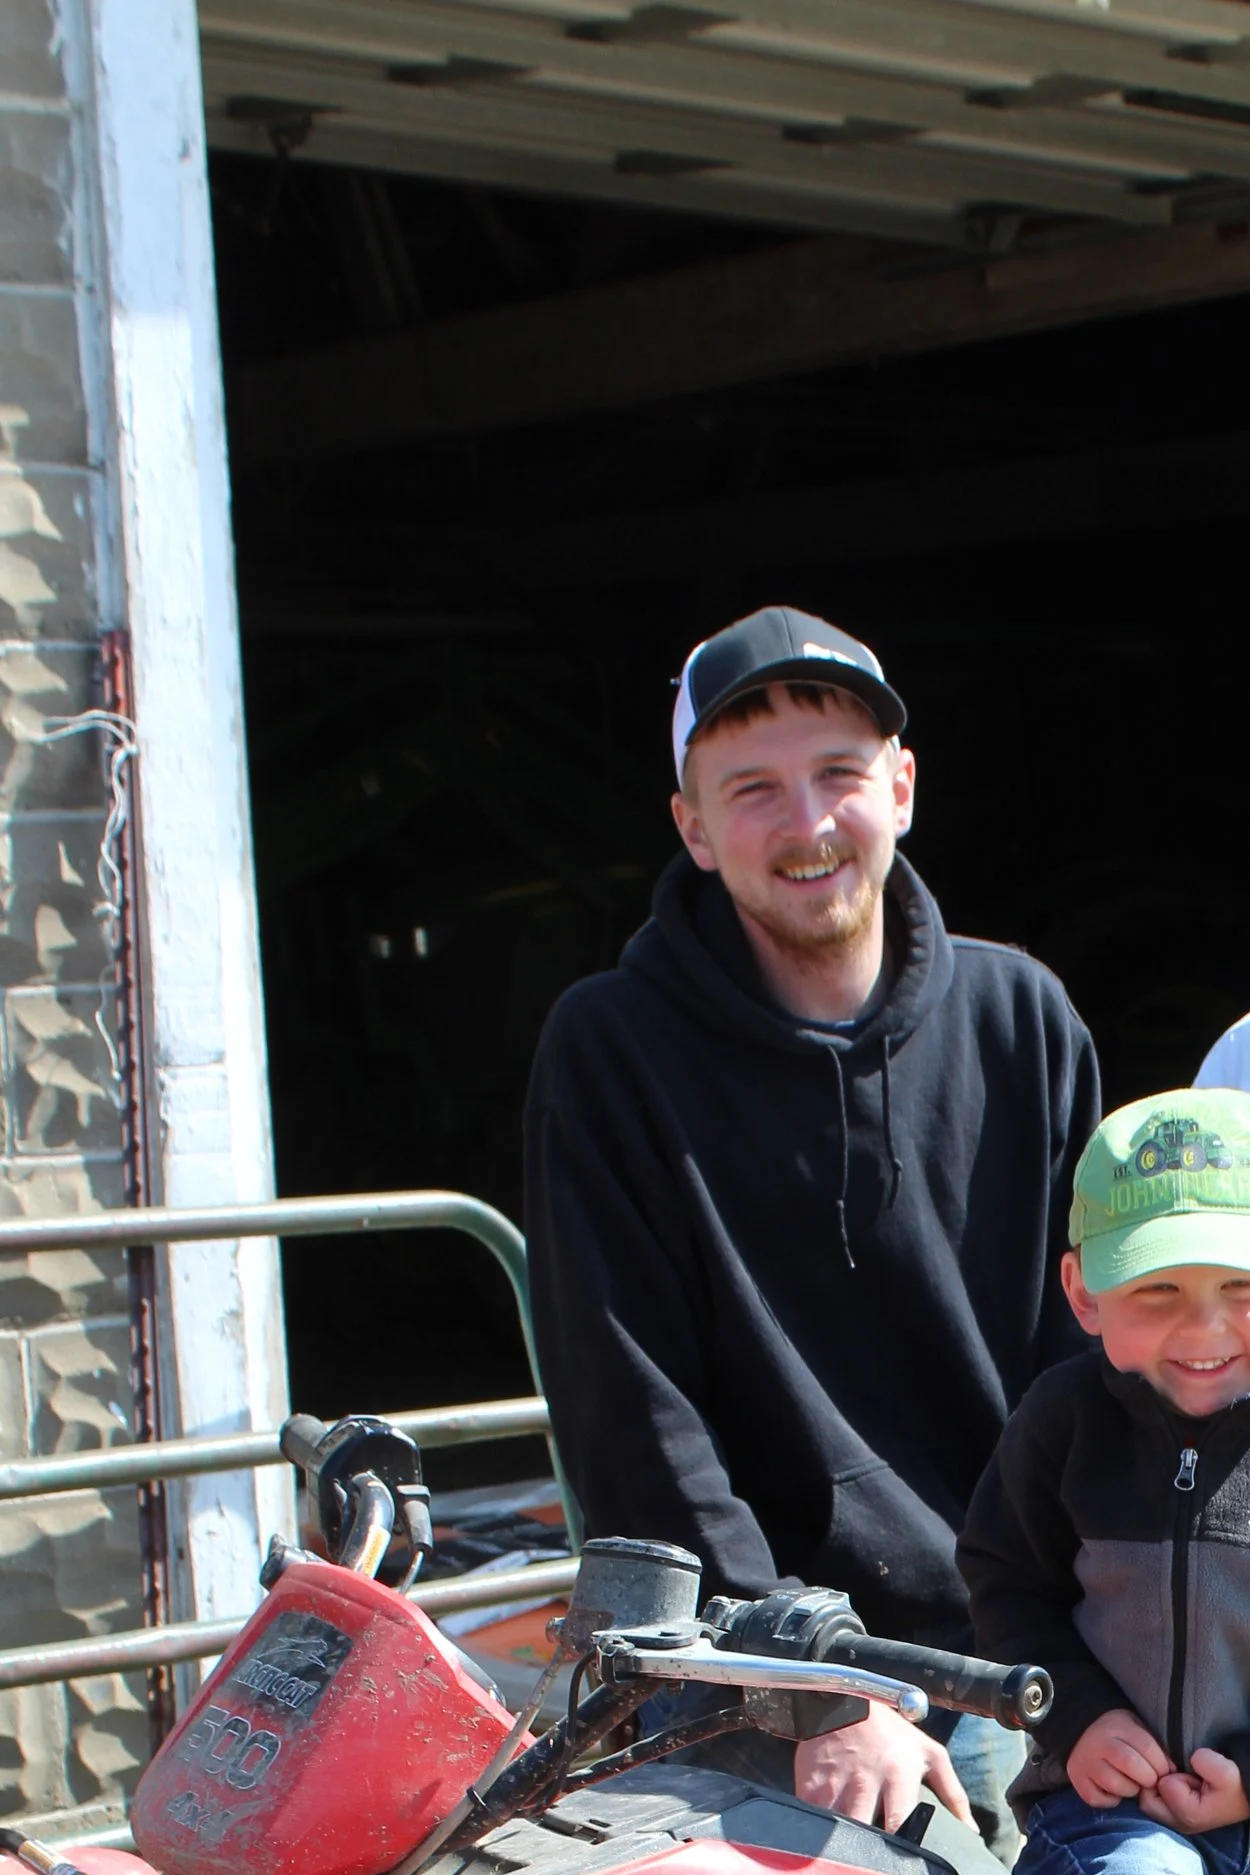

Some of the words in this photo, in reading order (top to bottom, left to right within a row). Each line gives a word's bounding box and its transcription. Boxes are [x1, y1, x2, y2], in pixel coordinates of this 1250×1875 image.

[1105, 1174, 1171, 1217] JOHN
[280, 1673, 322, 1710] CAT
[182, 1705, 281, 1790] 500
